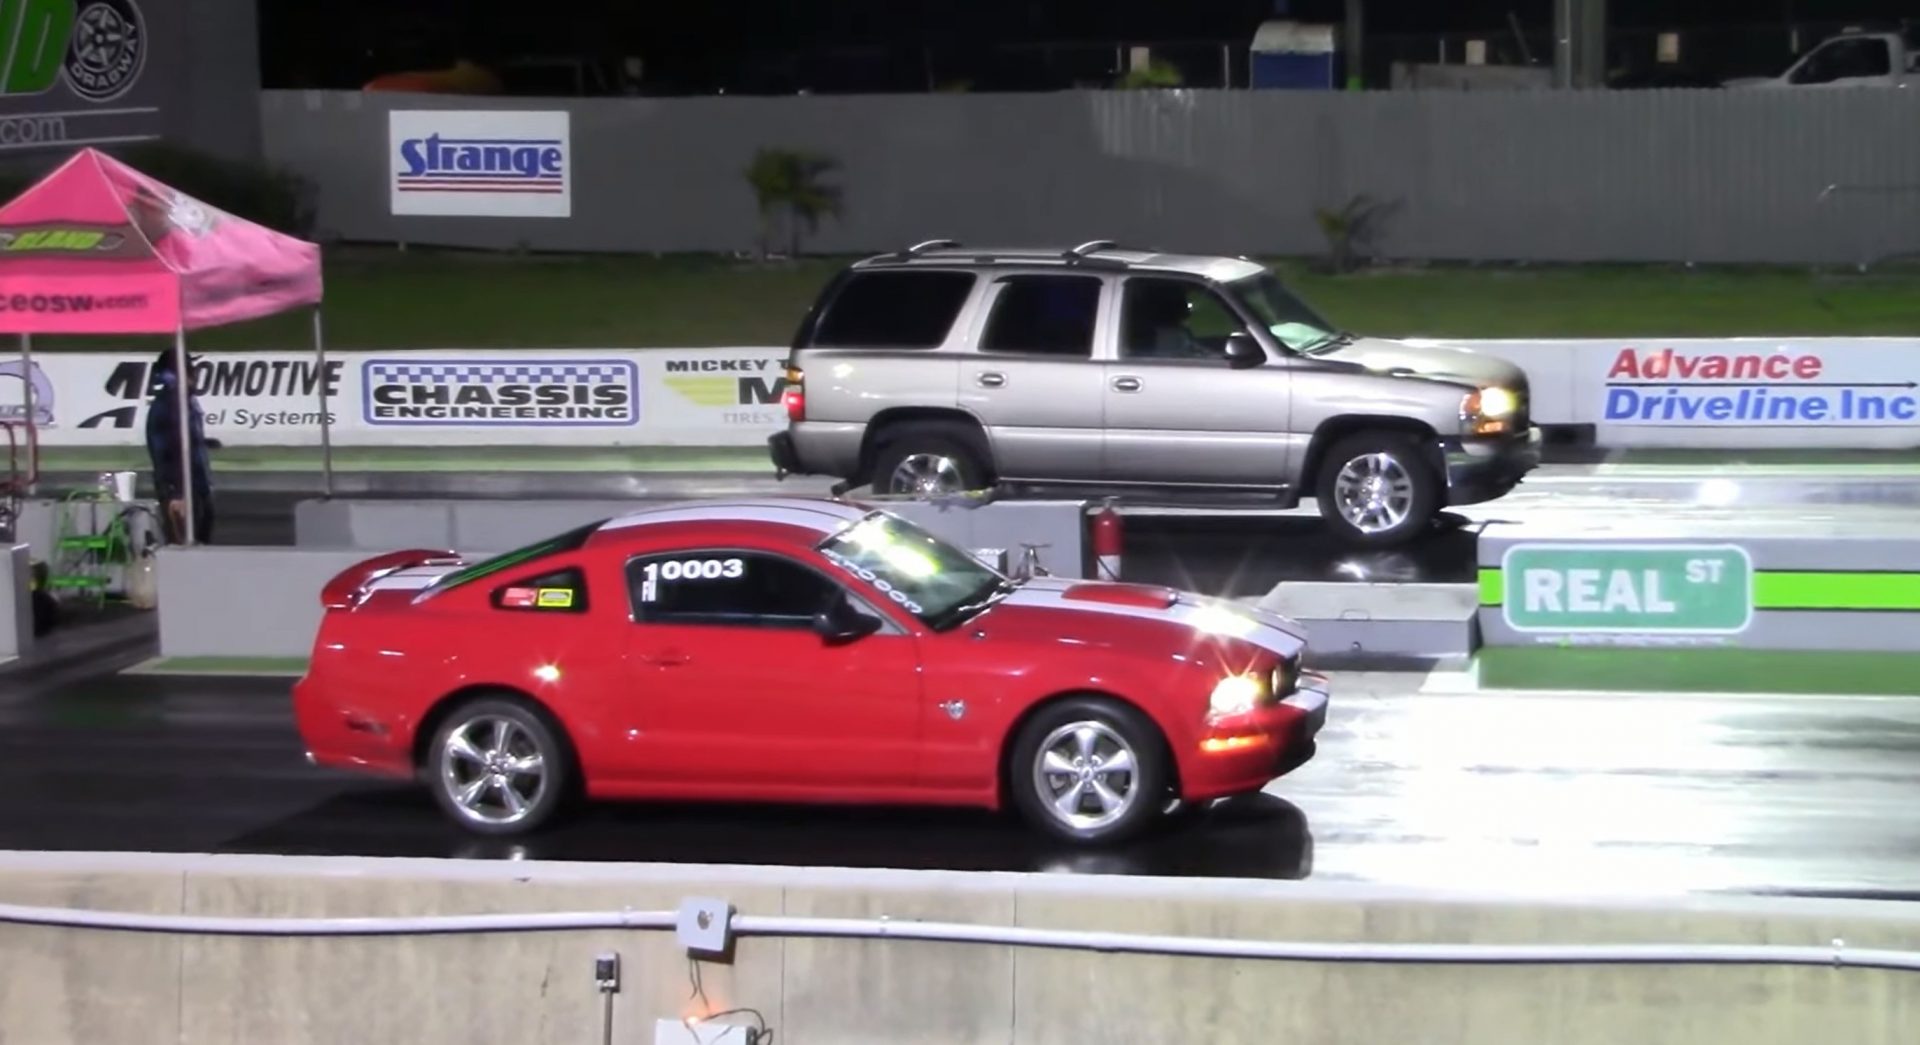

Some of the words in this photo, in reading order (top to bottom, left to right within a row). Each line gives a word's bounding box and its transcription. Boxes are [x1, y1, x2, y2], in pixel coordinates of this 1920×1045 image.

[70, 22, 138, 88] DRAGWAY
[401, 133, 562, 178] Strange
[666, 359, 768, 372] MICKEY
[1608, 349, 1822, 379] Advance
[373, 384, 627, 405] CHASSIS
[234, 409, 337, 429] Systems
[374, 406, 628, 418] ENGINEERING
[723, 413, 774, 424] TIRES
[1523, 568, 1675, 613] REAL
[1686, 559, 1724, 583] ST
